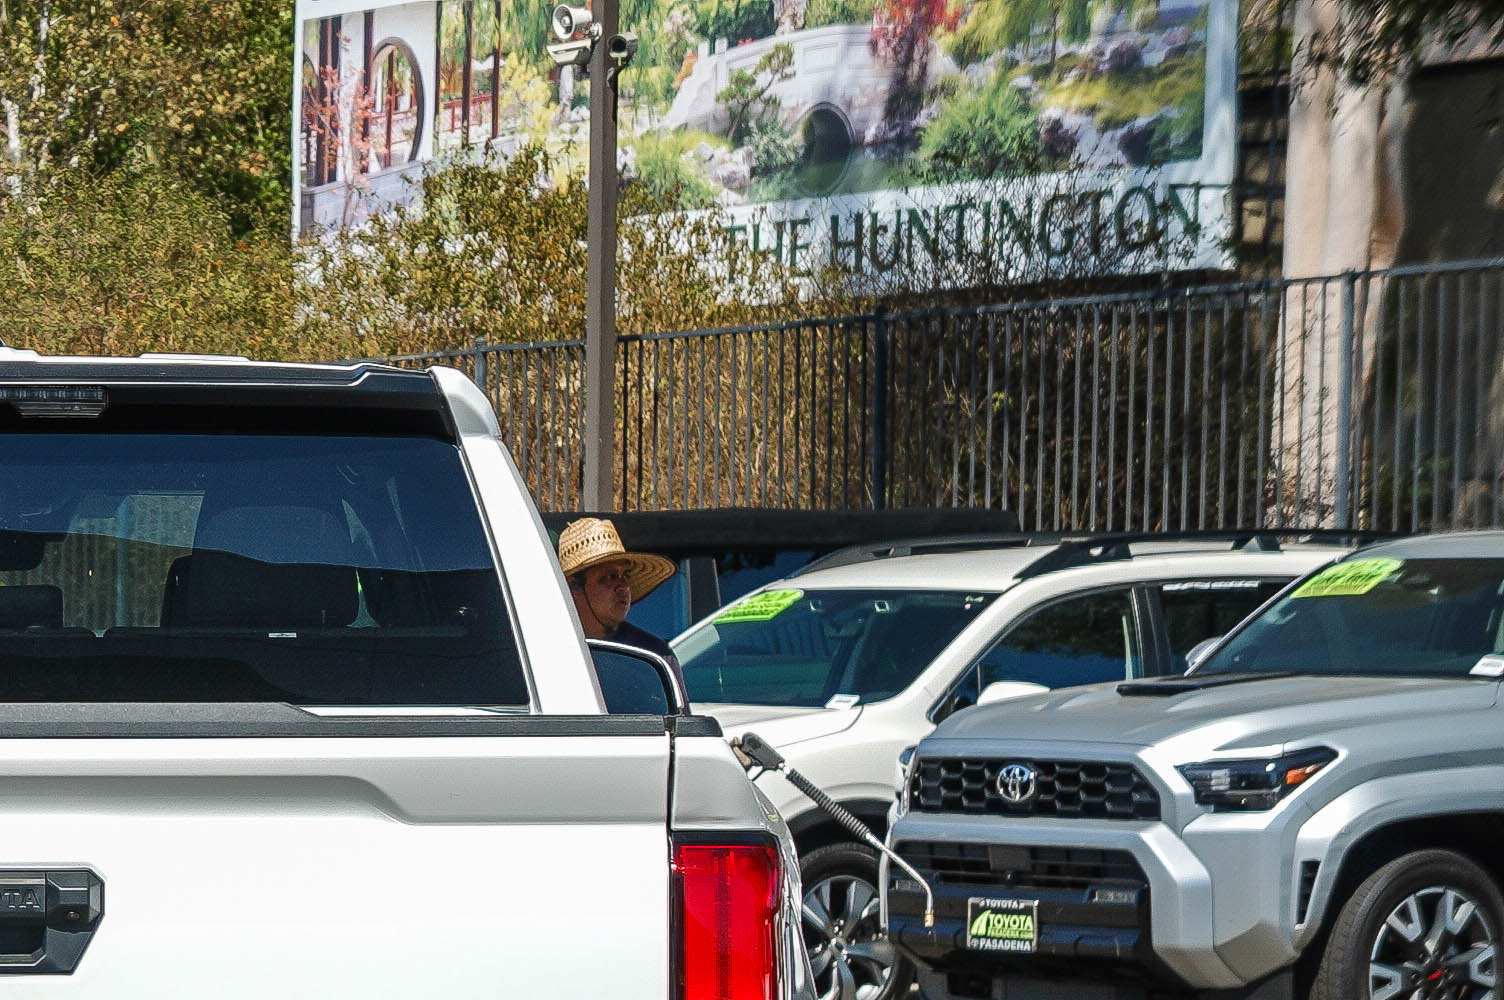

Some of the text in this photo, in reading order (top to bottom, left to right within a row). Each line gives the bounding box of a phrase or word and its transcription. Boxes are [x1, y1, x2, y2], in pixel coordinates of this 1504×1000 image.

[723, 183, 1202, 284] THE HUNTINGTON
[986, 899, 1018, 909] TOYOTA
[988, 913, 1033, 930] TOYOTA
[980, 939, 1030, 951] PASADENA
